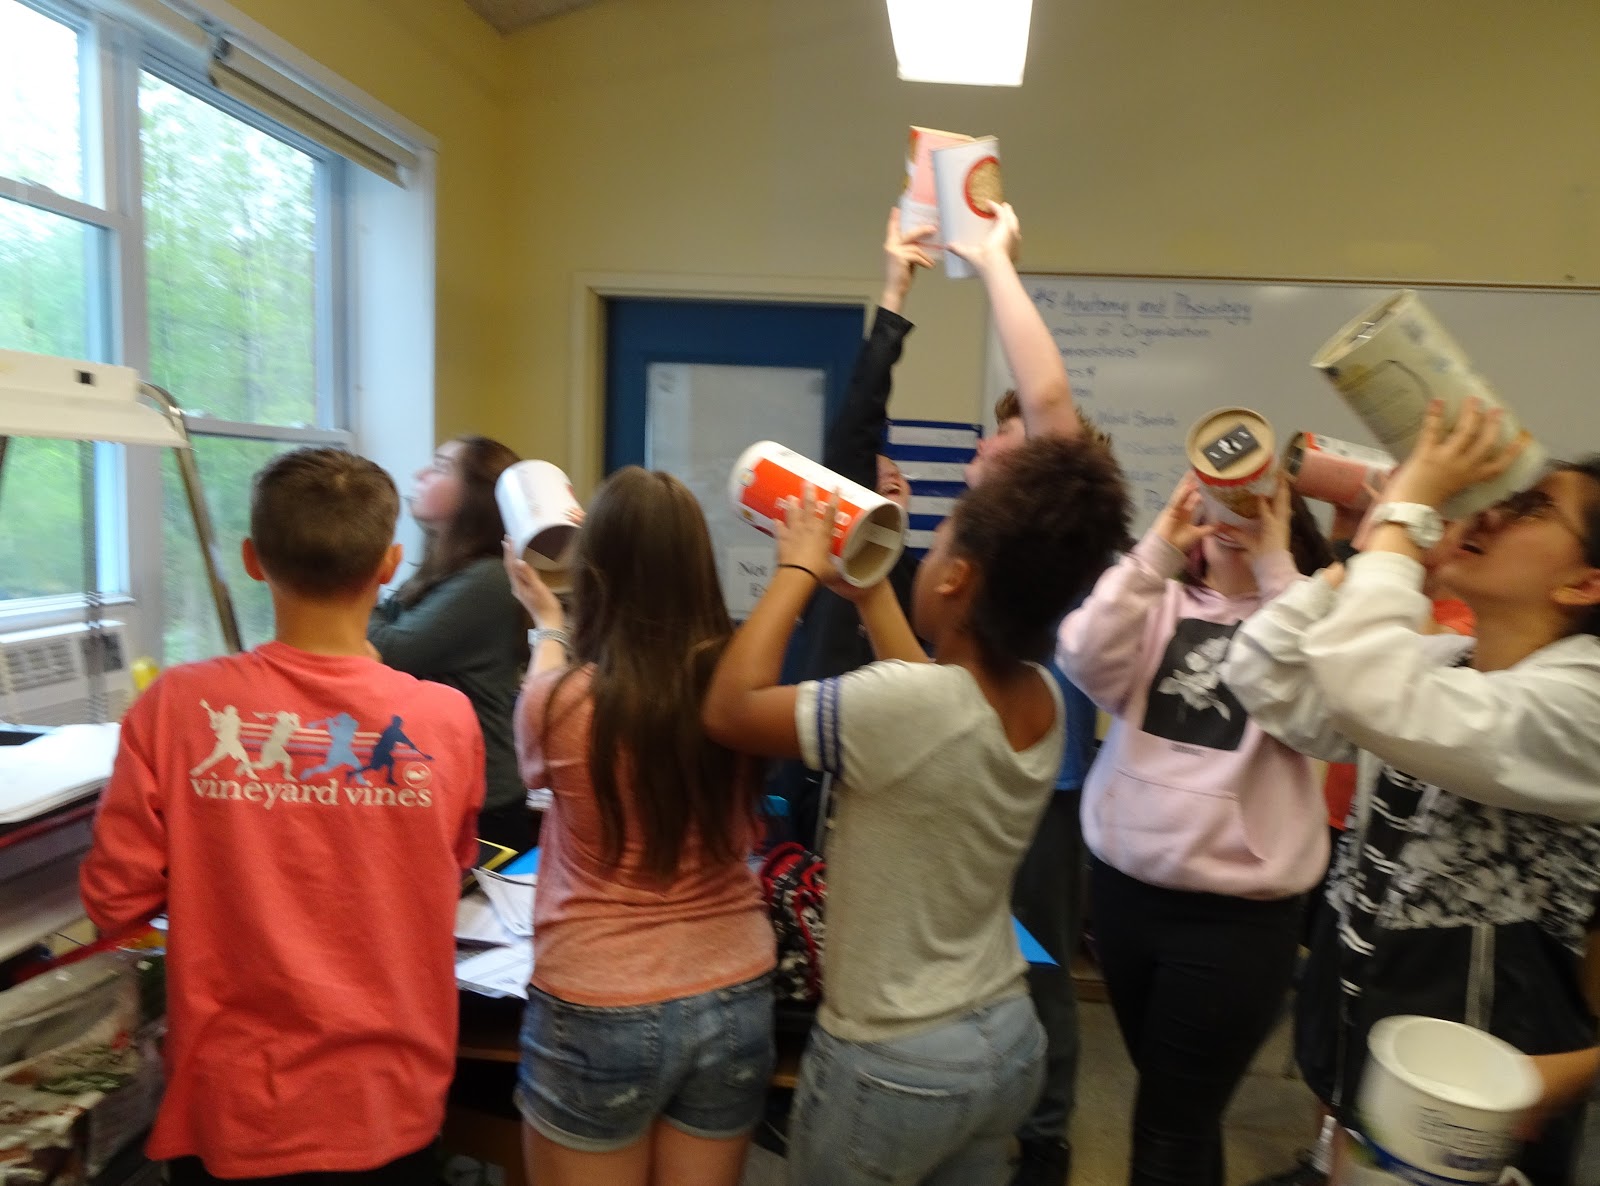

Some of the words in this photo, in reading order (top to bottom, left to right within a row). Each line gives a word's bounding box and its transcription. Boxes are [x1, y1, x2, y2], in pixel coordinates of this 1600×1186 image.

[1137, 295, 1166, 313] and
[738, 561, 767, 577] Not
[190, 772, 339, 809] vineyard
[344, 780, 432, 807] vines
